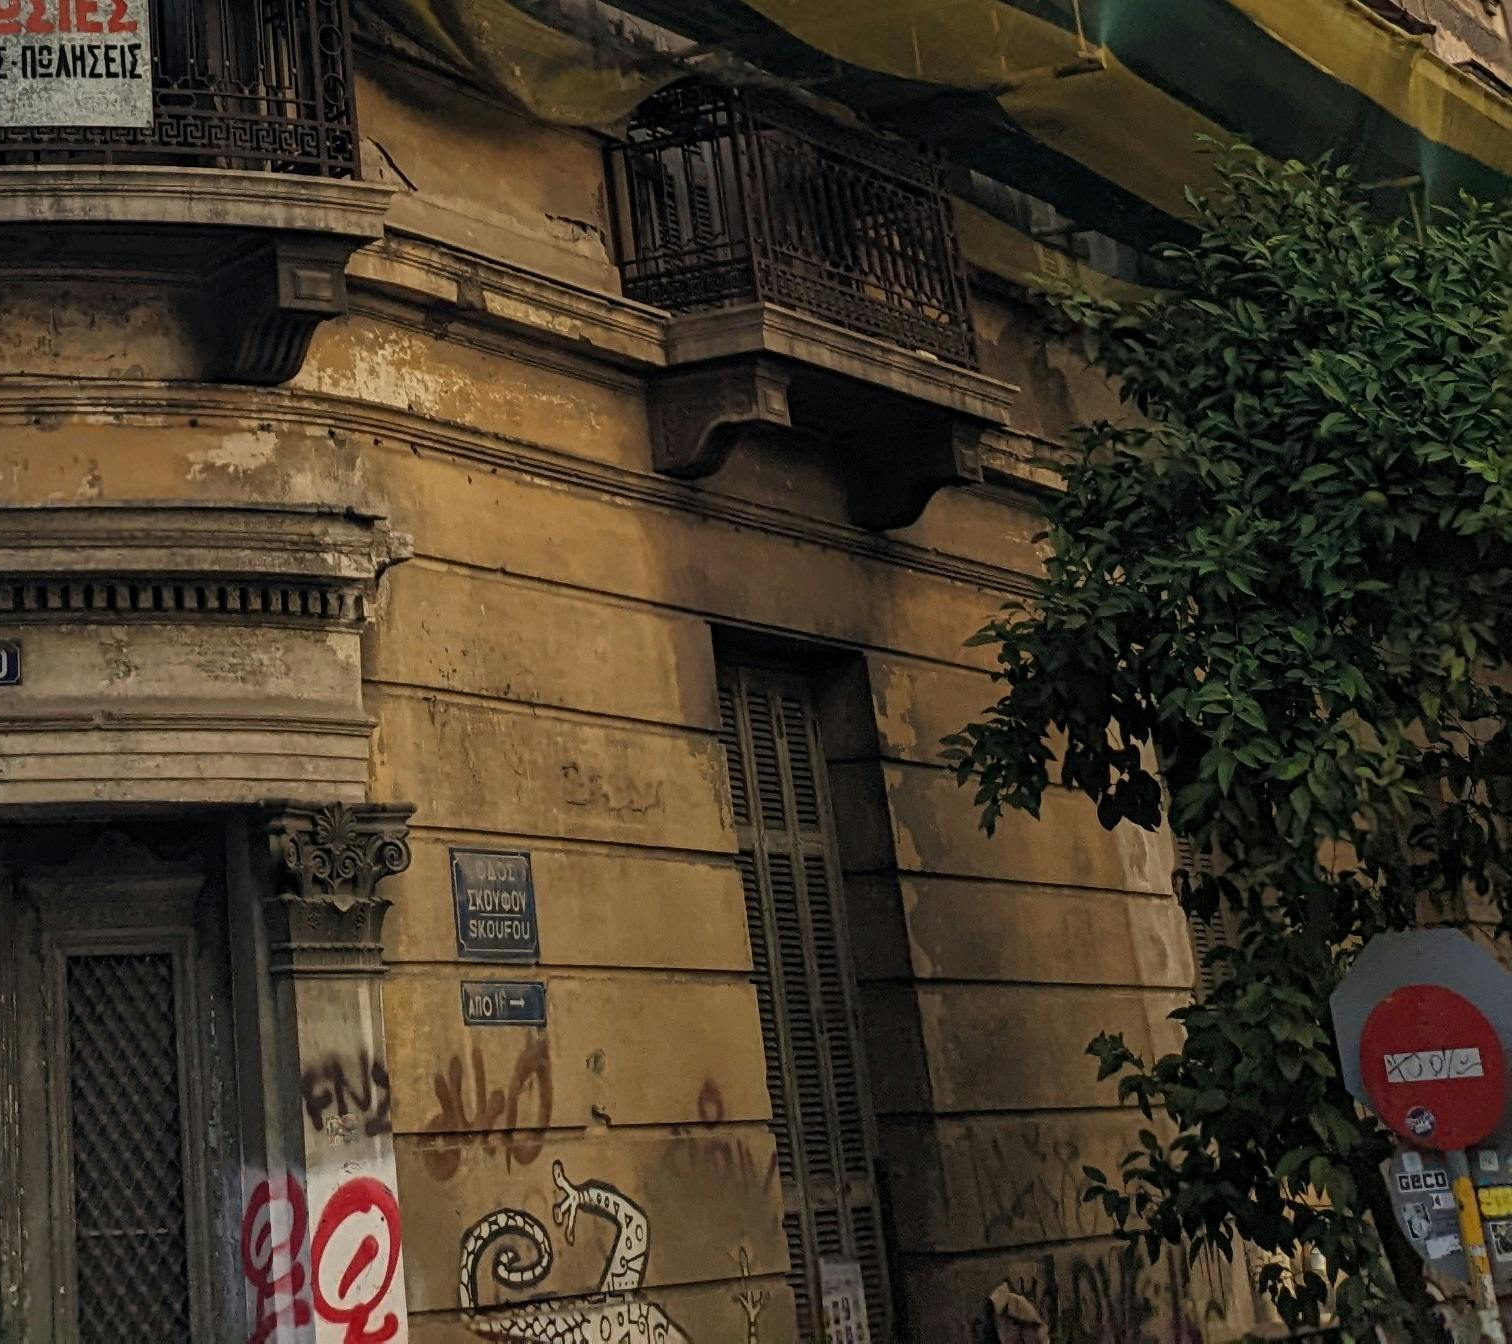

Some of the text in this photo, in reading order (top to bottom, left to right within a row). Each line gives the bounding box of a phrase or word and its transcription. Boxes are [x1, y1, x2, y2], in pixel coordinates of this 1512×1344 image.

[467, 888, 526, 912] ΣΚΟΥΦΟΥ
[469, 919, 530, 940] SKOUFOU
[468, 996, 493, 1017] ΑΠΟ
